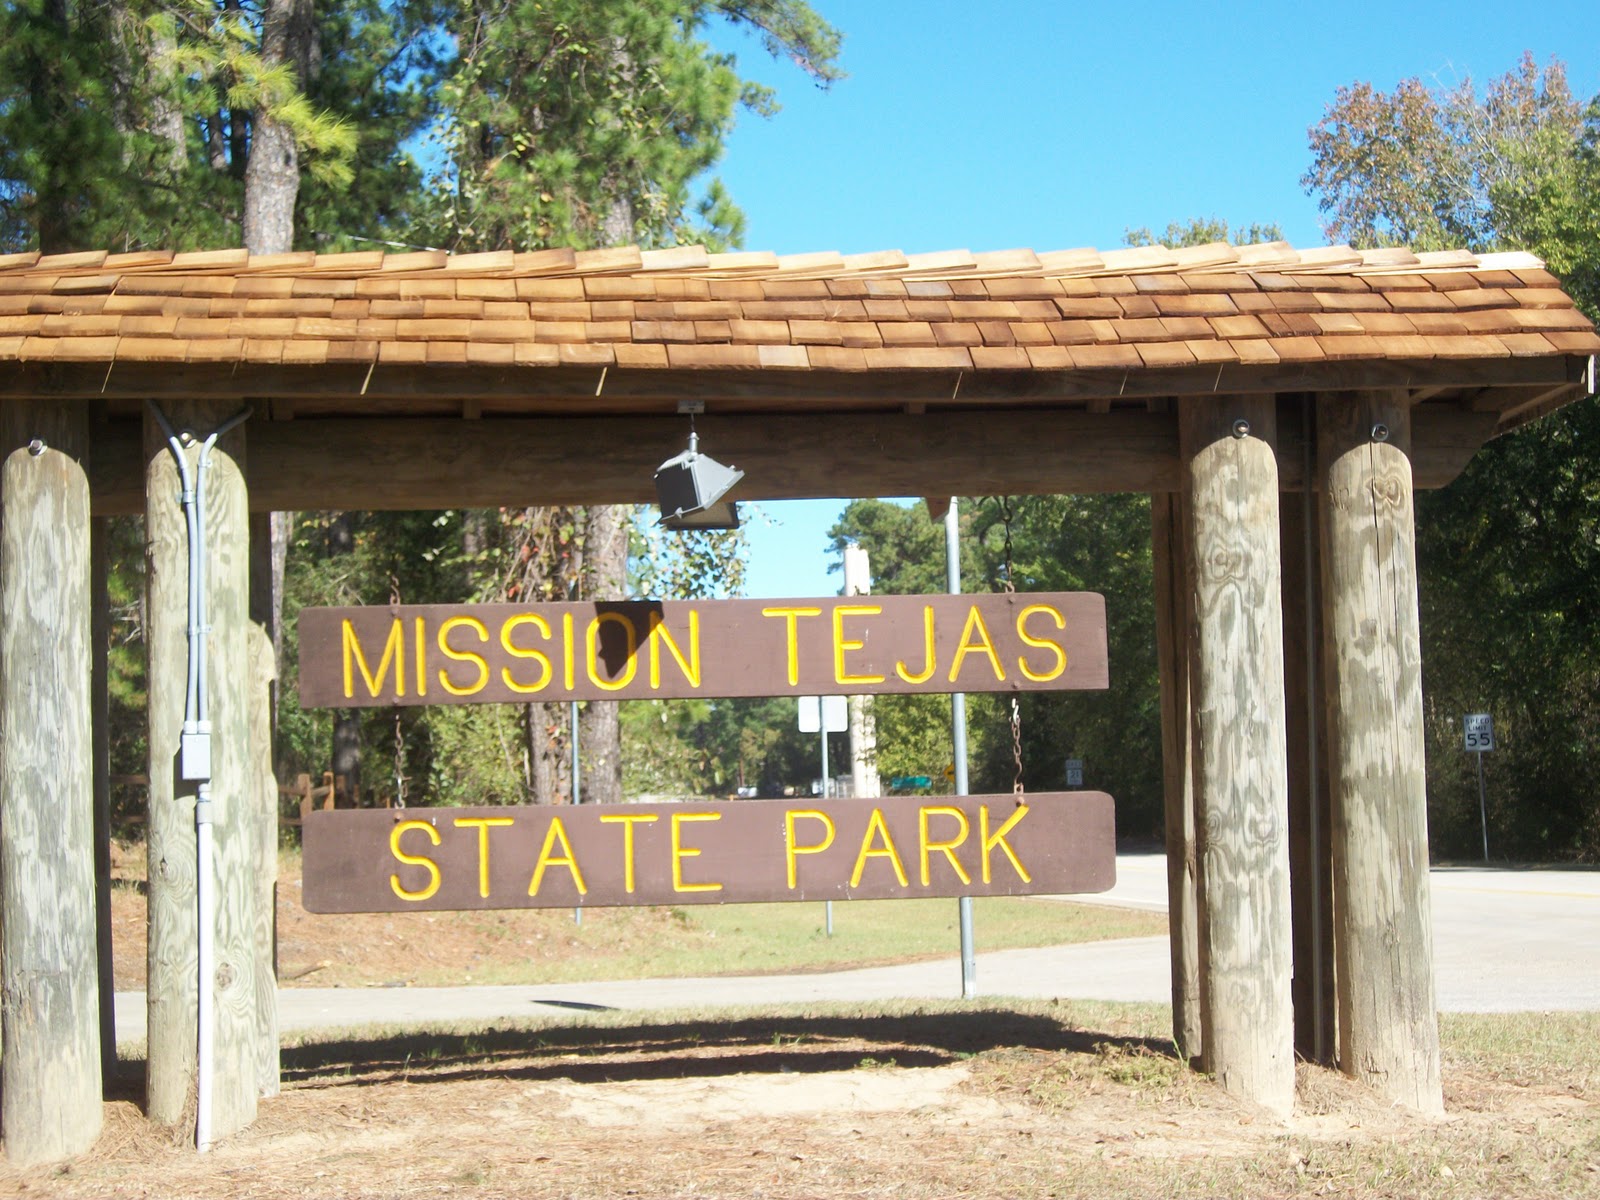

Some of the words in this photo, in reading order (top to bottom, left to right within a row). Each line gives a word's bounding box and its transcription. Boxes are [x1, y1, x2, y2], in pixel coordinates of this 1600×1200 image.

[341, 611, 702, 698] MISSION
[761, 604, 1067, 687] TEJAS
[1467, 733, 1490, 747] 55
[390, 812, 723, 901] STATE
[785, 804, 1032, 889] PARK
